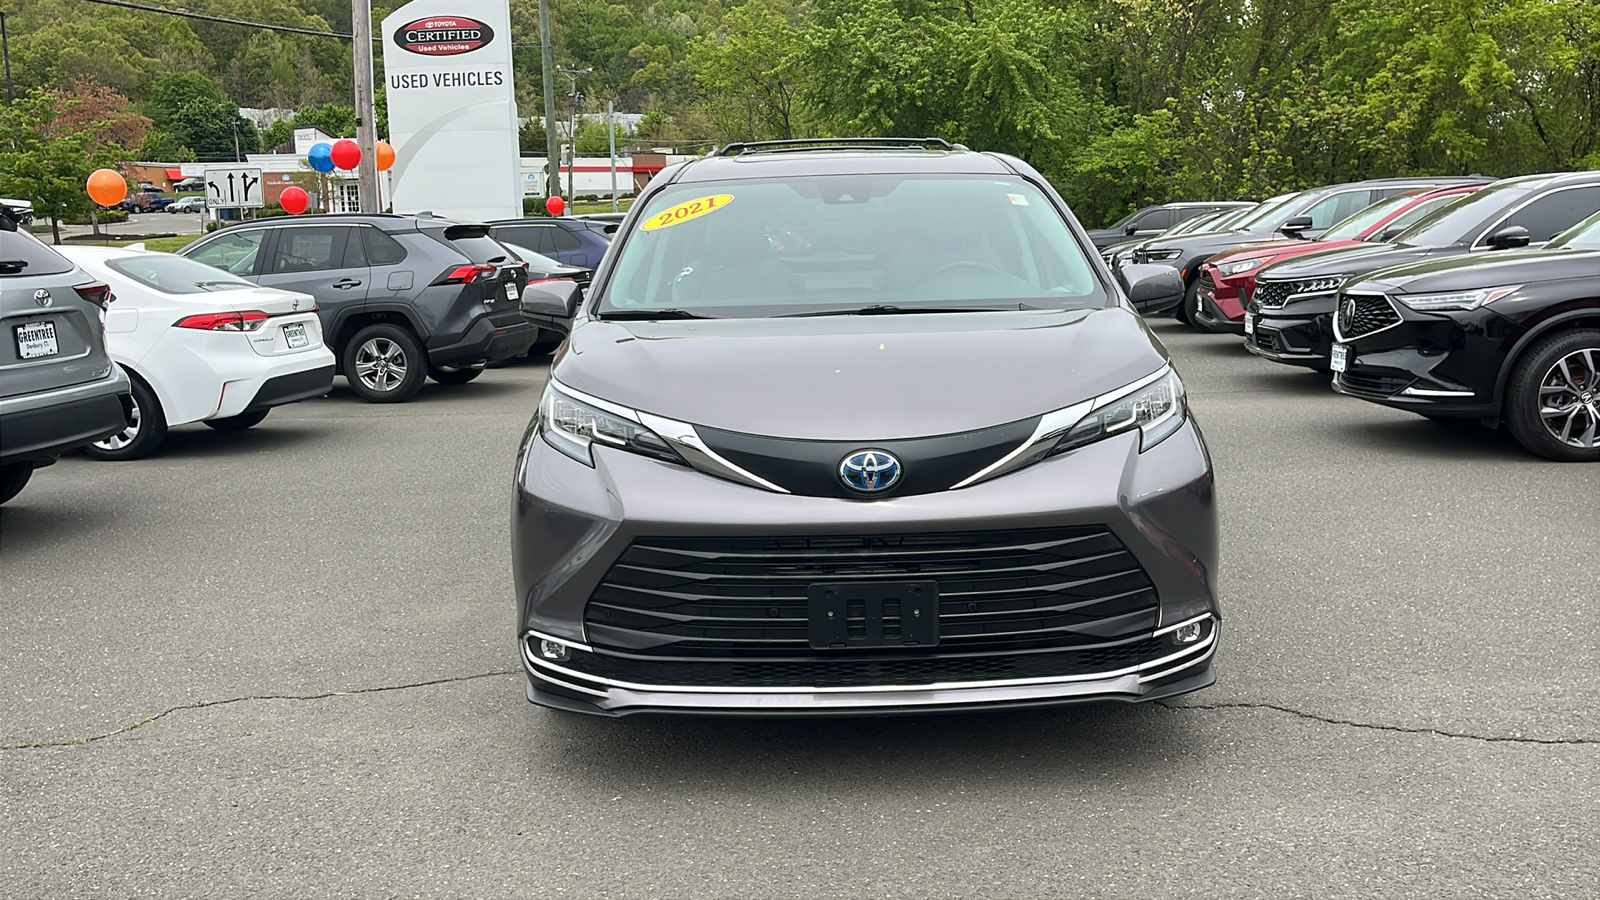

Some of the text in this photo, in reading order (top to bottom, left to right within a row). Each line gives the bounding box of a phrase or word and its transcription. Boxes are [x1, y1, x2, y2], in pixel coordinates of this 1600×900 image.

[405, 30, 481, 43] CERTIFIED
[391, 71, 503, 89] USED VEHICLES
[659, 197, 717, 226] 2021
[18, 328, 54, 343] GREENTREE
